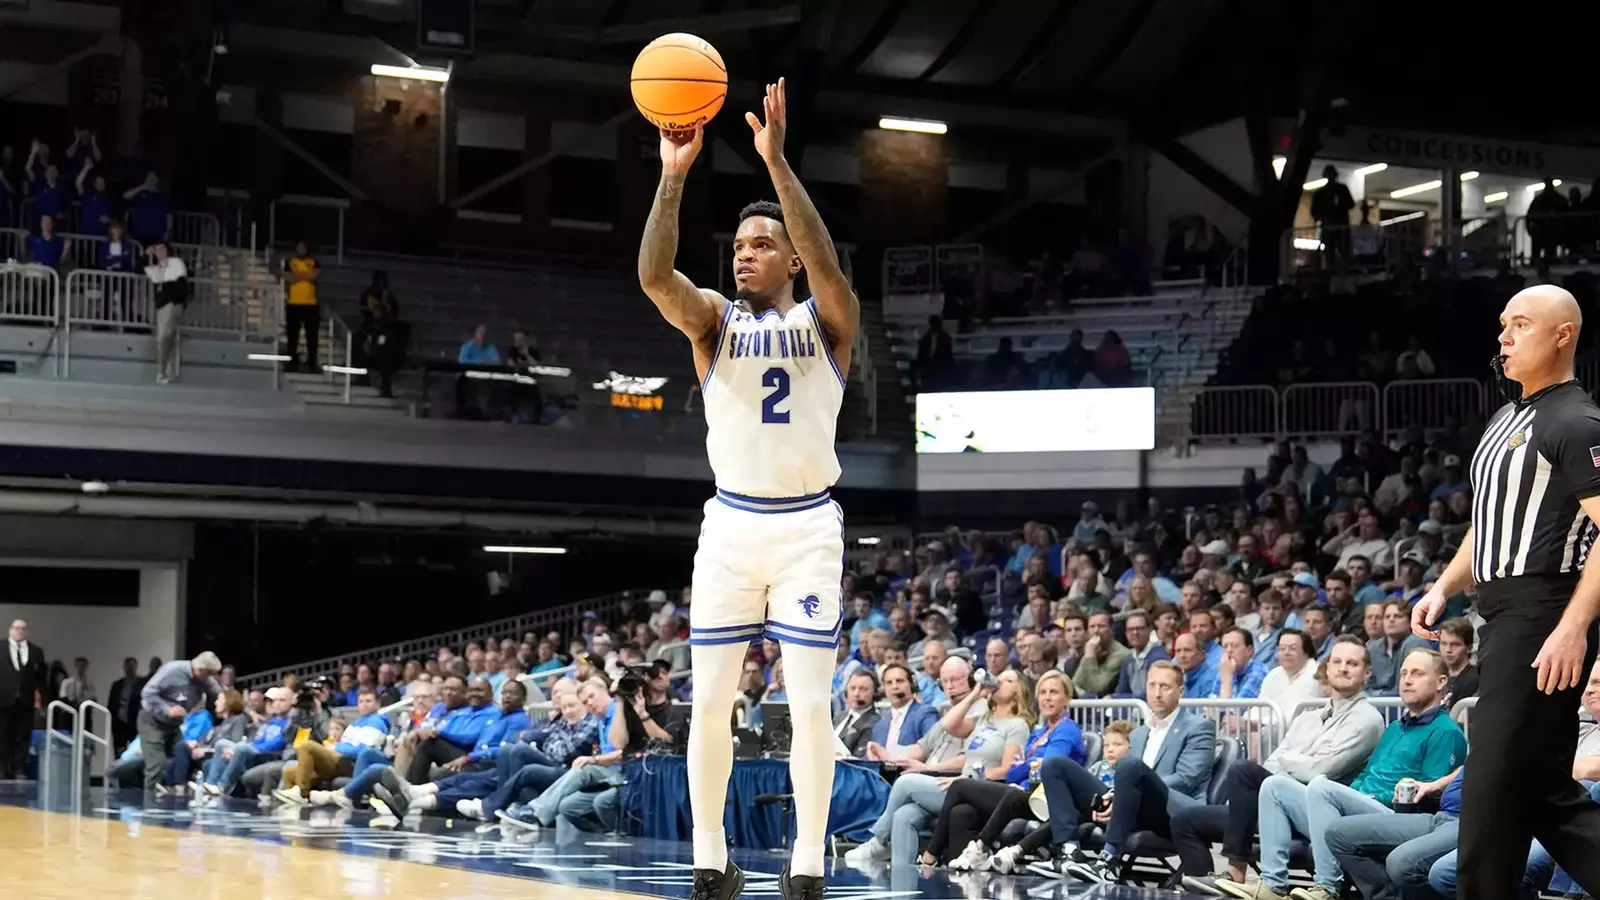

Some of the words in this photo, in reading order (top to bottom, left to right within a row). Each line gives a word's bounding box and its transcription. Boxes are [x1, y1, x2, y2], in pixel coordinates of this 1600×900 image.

[1366, 132, 1545, 169] CONCESSIONS
[777, 328, 816, 358] HALL
[761, 366, 791, 424] 2
